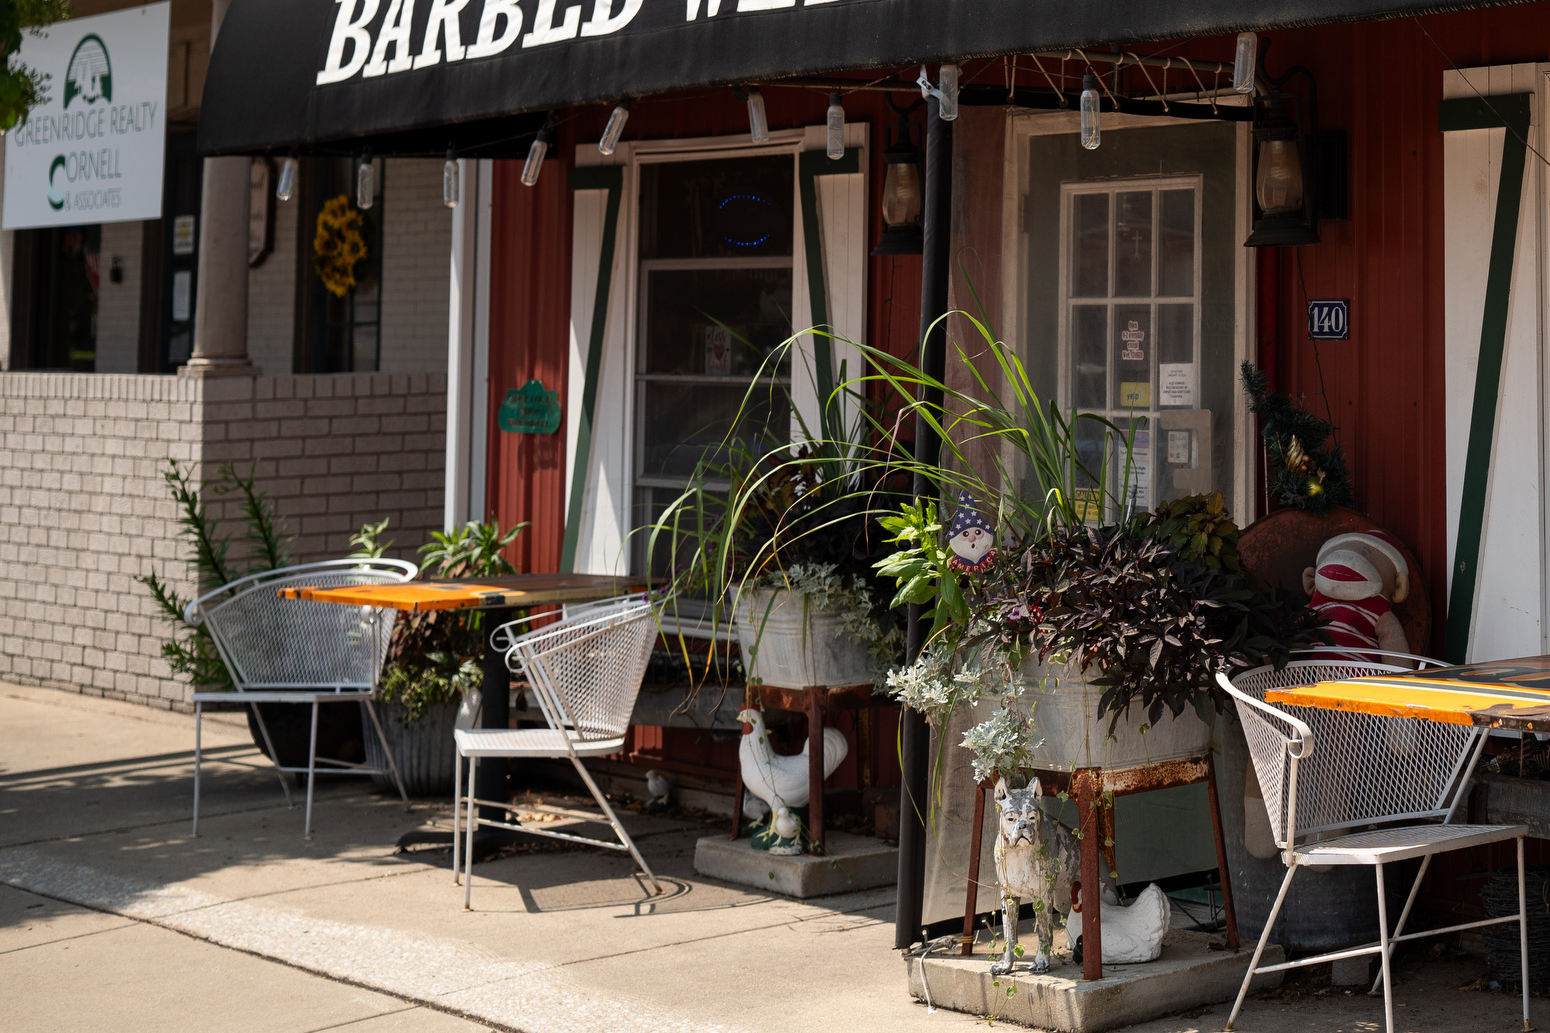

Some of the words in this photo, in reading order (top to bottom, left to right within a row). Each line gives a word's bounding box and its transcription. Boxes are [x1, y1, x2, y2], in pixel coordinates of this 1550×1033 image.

[14, 108, 105, 147] GREENRIDGE
[110, 101, 158, 135] REALTY
[48, 148, 122, 212] CORNELL
[73, 187, 122, 210] ASSOCIATES
[1312, 307, 1344, 333] 140
[1126, 391, 1139, 401] yep
[952, 550, 996, 572] AMERICA
